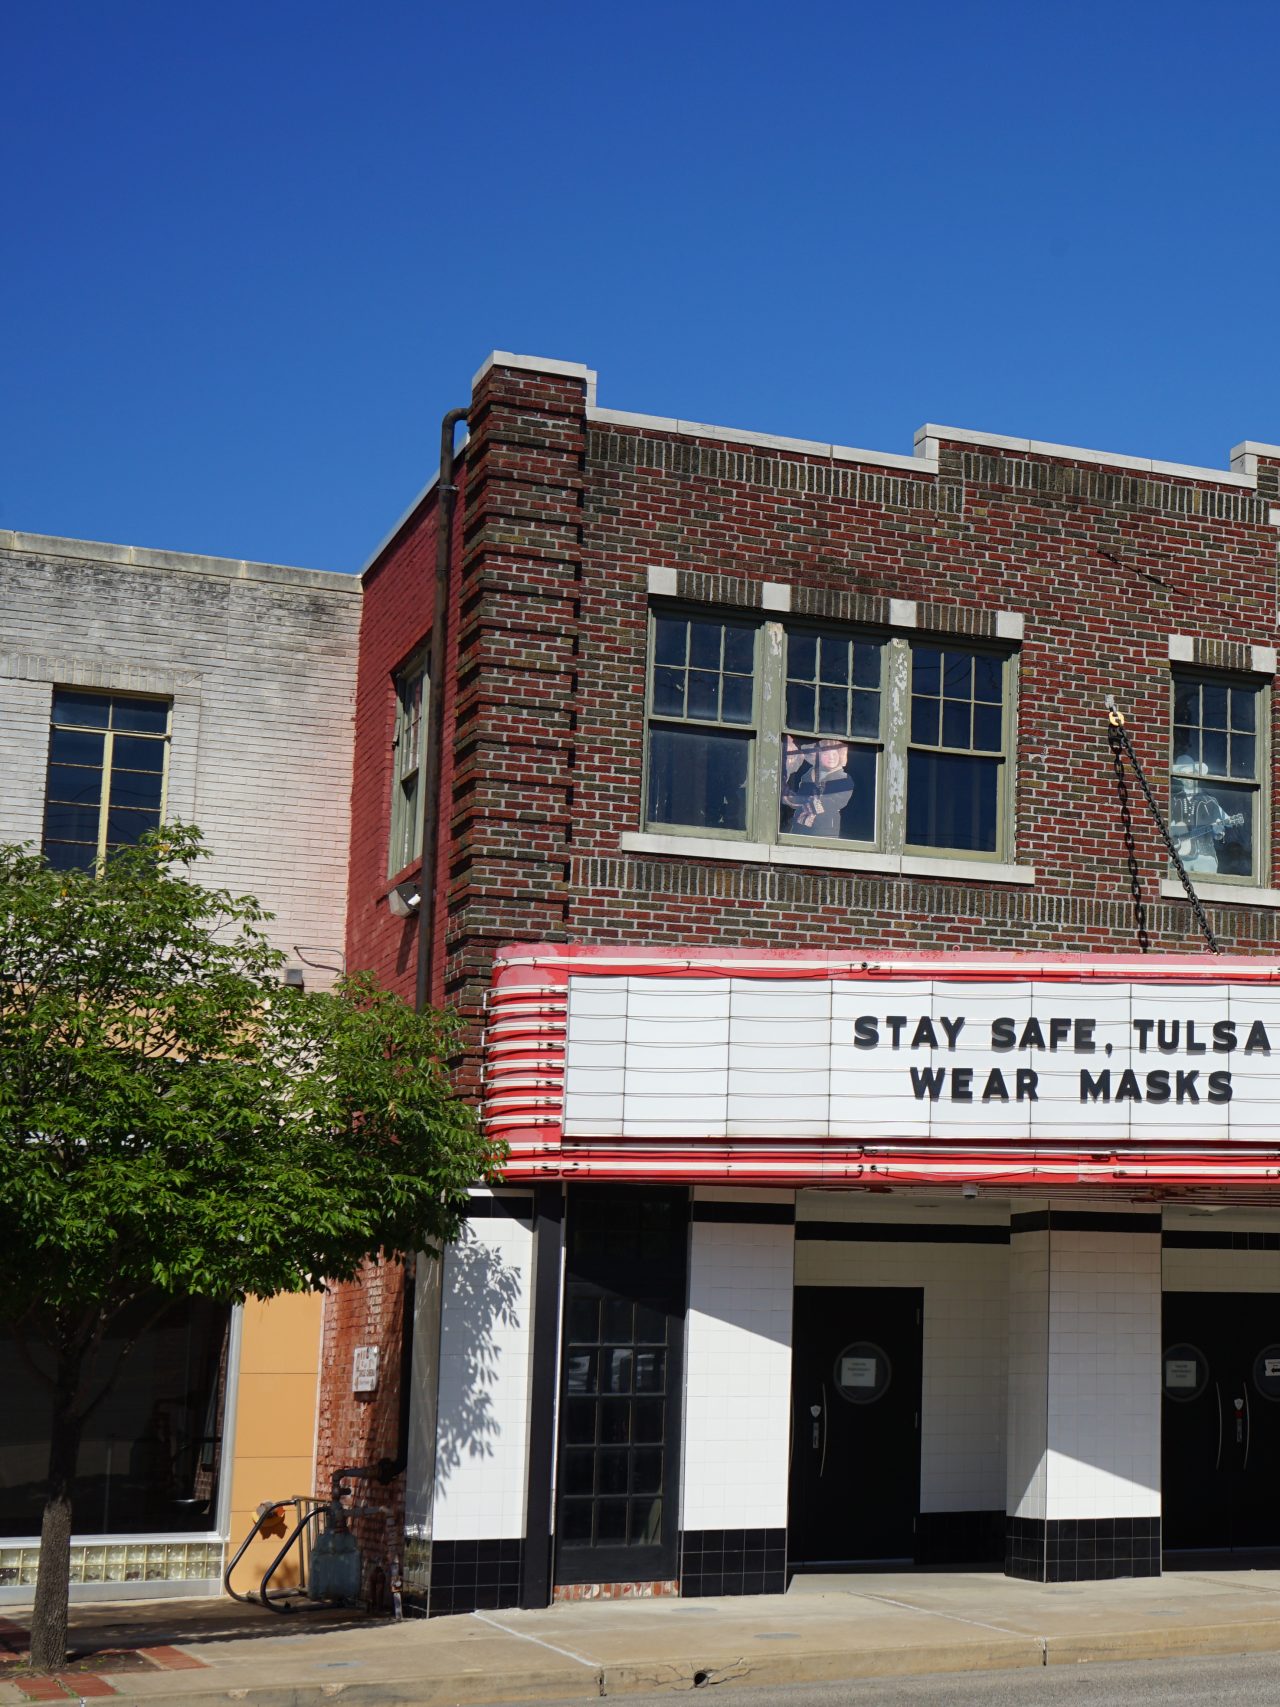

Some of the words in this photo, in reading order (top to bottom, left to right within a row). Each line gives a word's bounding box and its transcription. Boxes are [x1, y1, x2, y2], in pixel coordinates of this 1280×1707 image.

[853, 1015, 966, 1048] STAY
[990, 1017, 1114, 1056] SAFE,
[1133, 1018, 1272, 1053] TULSA
[910, 1066, 1039, 1100] WEAR
[1080, 1068, 1234, 1103] MASKS
